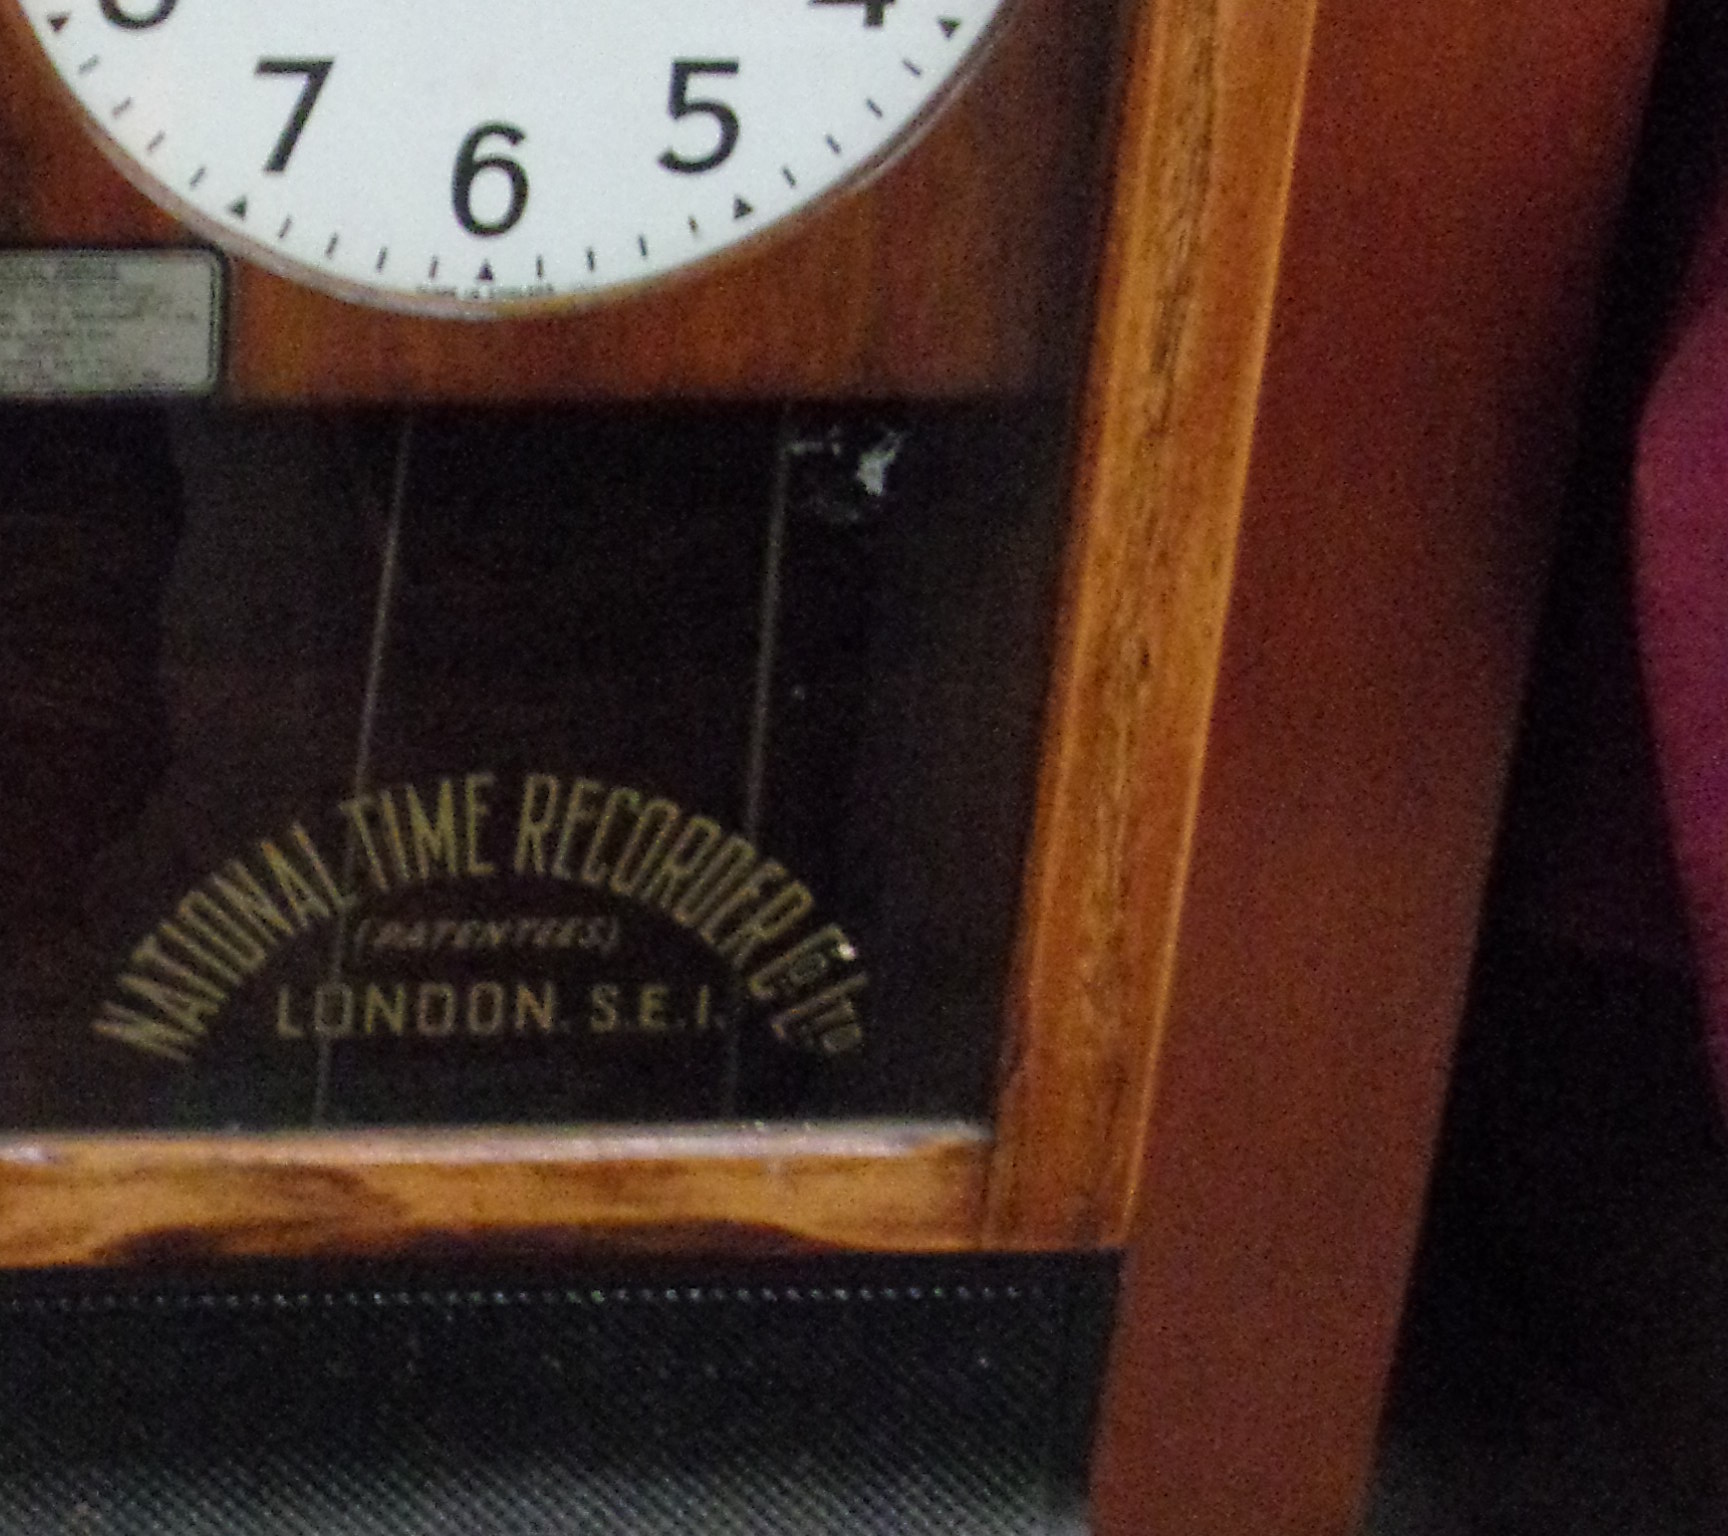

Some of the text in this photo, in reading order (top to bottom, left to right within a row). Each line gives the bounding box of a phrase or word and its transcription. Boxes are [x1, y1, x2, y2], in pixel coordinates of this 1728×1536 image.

[252, 59, 336, 176] 7
[657, 59, 742, 175] 5
[450, 123, 530, 237] 6
[91, 821, 359, 1065] NATIONAL
[339, 771, 497, 894] TIME
[514, 771, 815, 971] RECORDER
